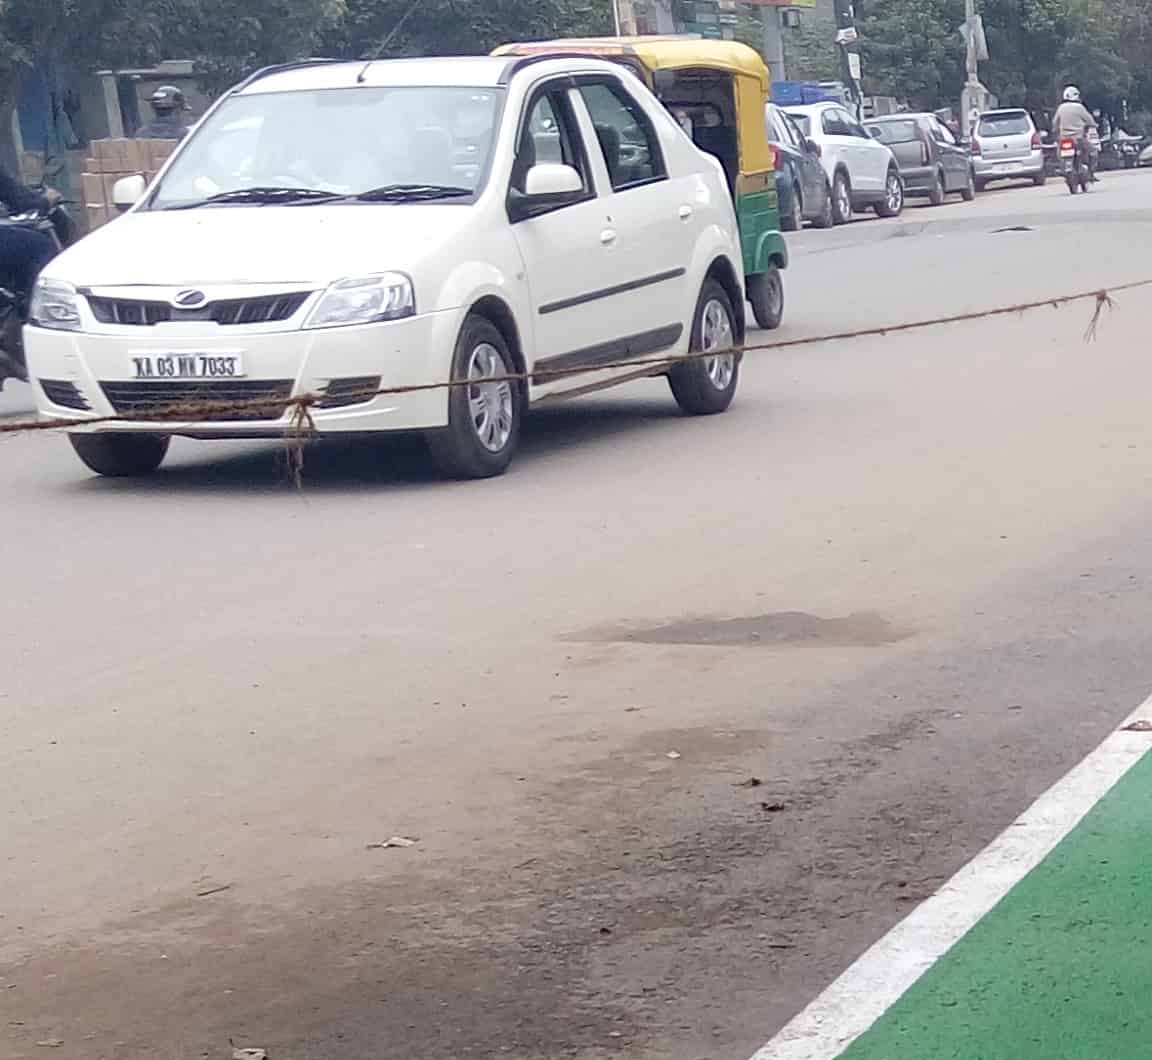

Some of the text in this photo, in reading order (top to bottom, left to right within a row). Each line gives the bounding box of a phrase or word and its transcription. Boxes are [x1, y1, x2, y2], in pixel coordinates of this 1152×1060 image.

[132, 357, 153, 376] KA
[157, 357, 174, 376] 03
[199, 357, 236, 376] 7033
